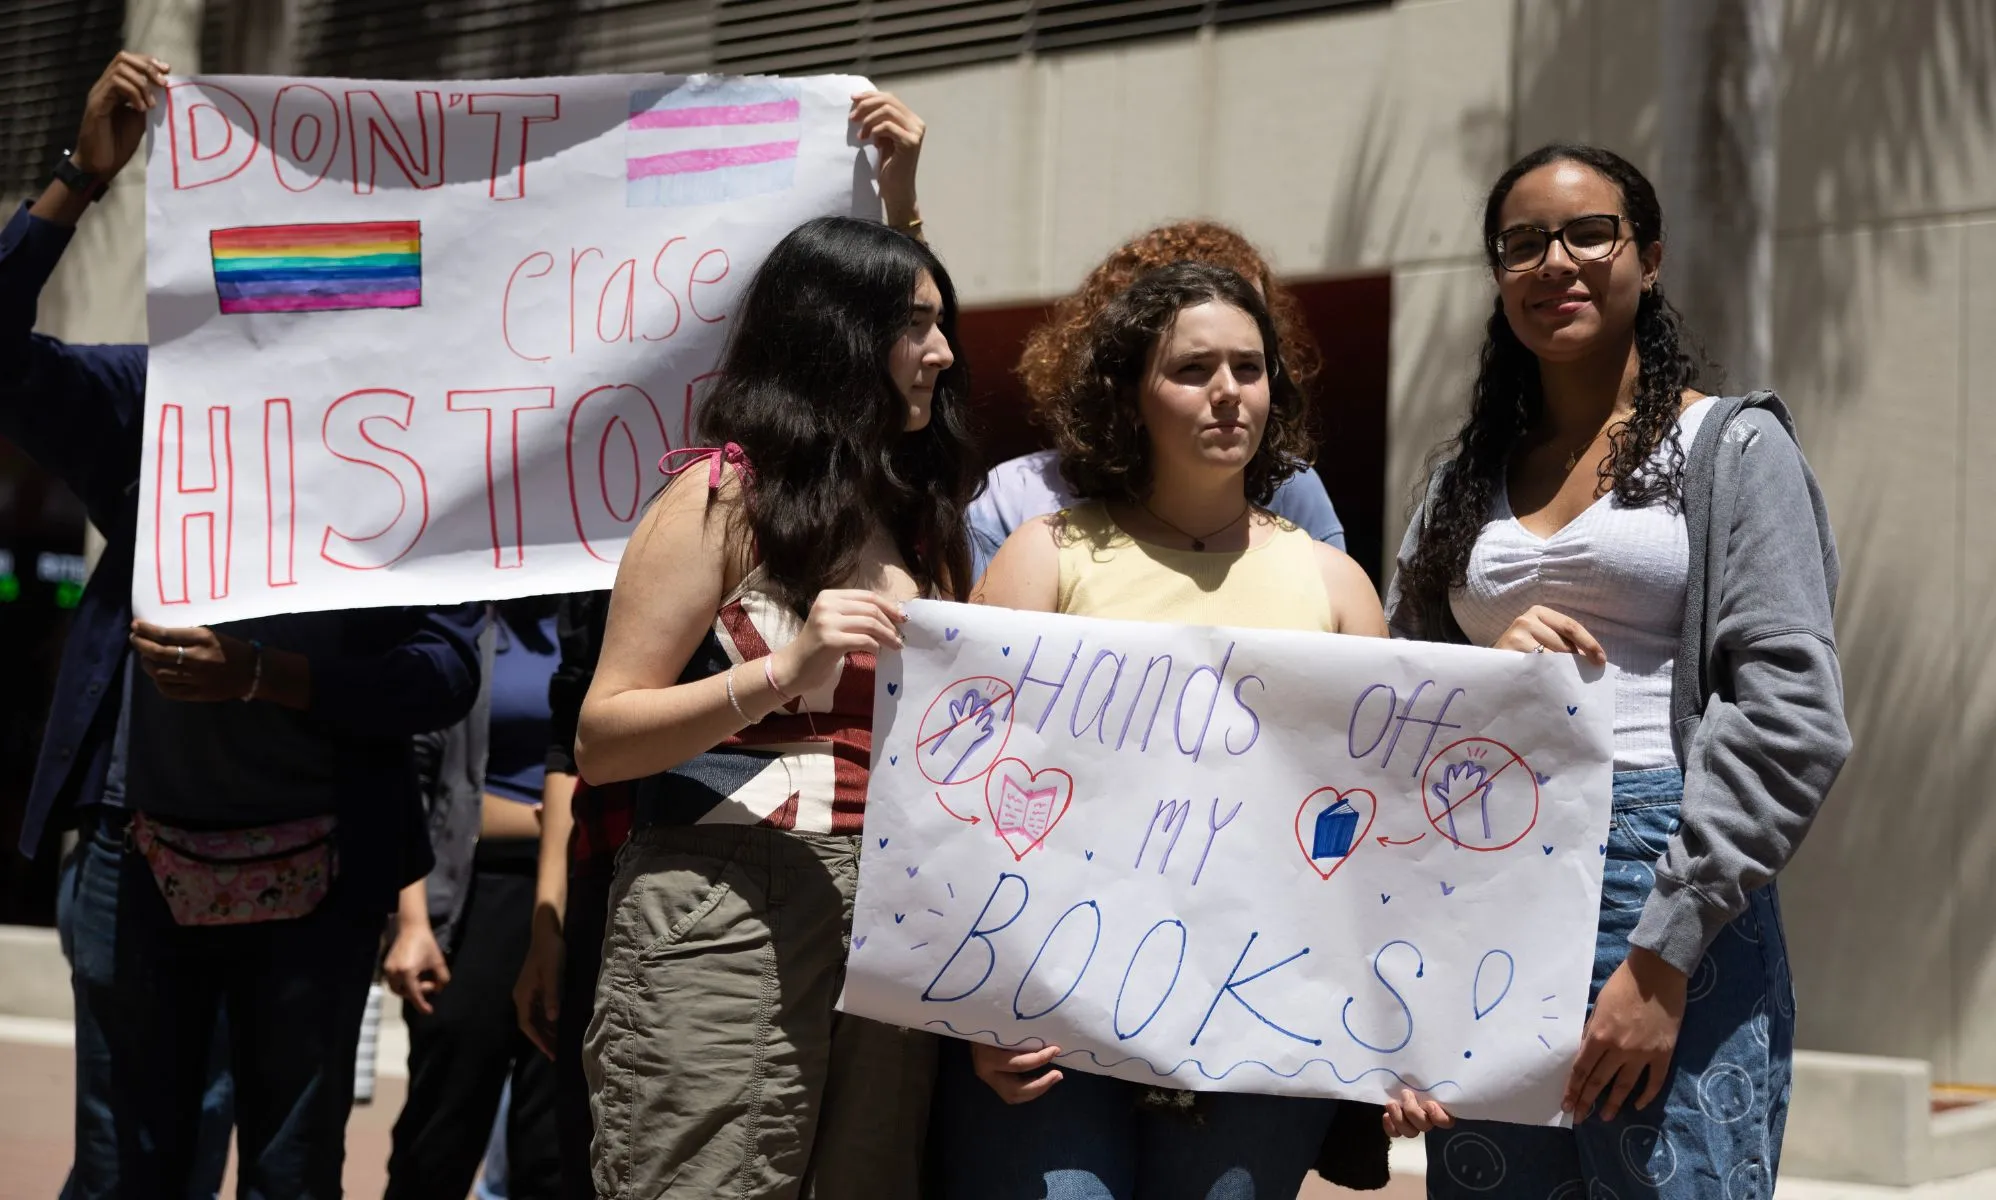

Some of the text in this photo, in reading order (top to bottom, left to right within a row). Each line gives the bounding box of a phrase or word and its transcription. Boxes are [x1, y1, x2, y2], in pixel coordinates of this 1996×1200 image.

[167, 83, 560, 200] DON'T
[503, 237, 731, 361] erase
[156, 370, 728, 604] HISTO
[1001, 635, 1466, 778] Hands Off
[921, 873, 1515, 1060] BOOKS!
